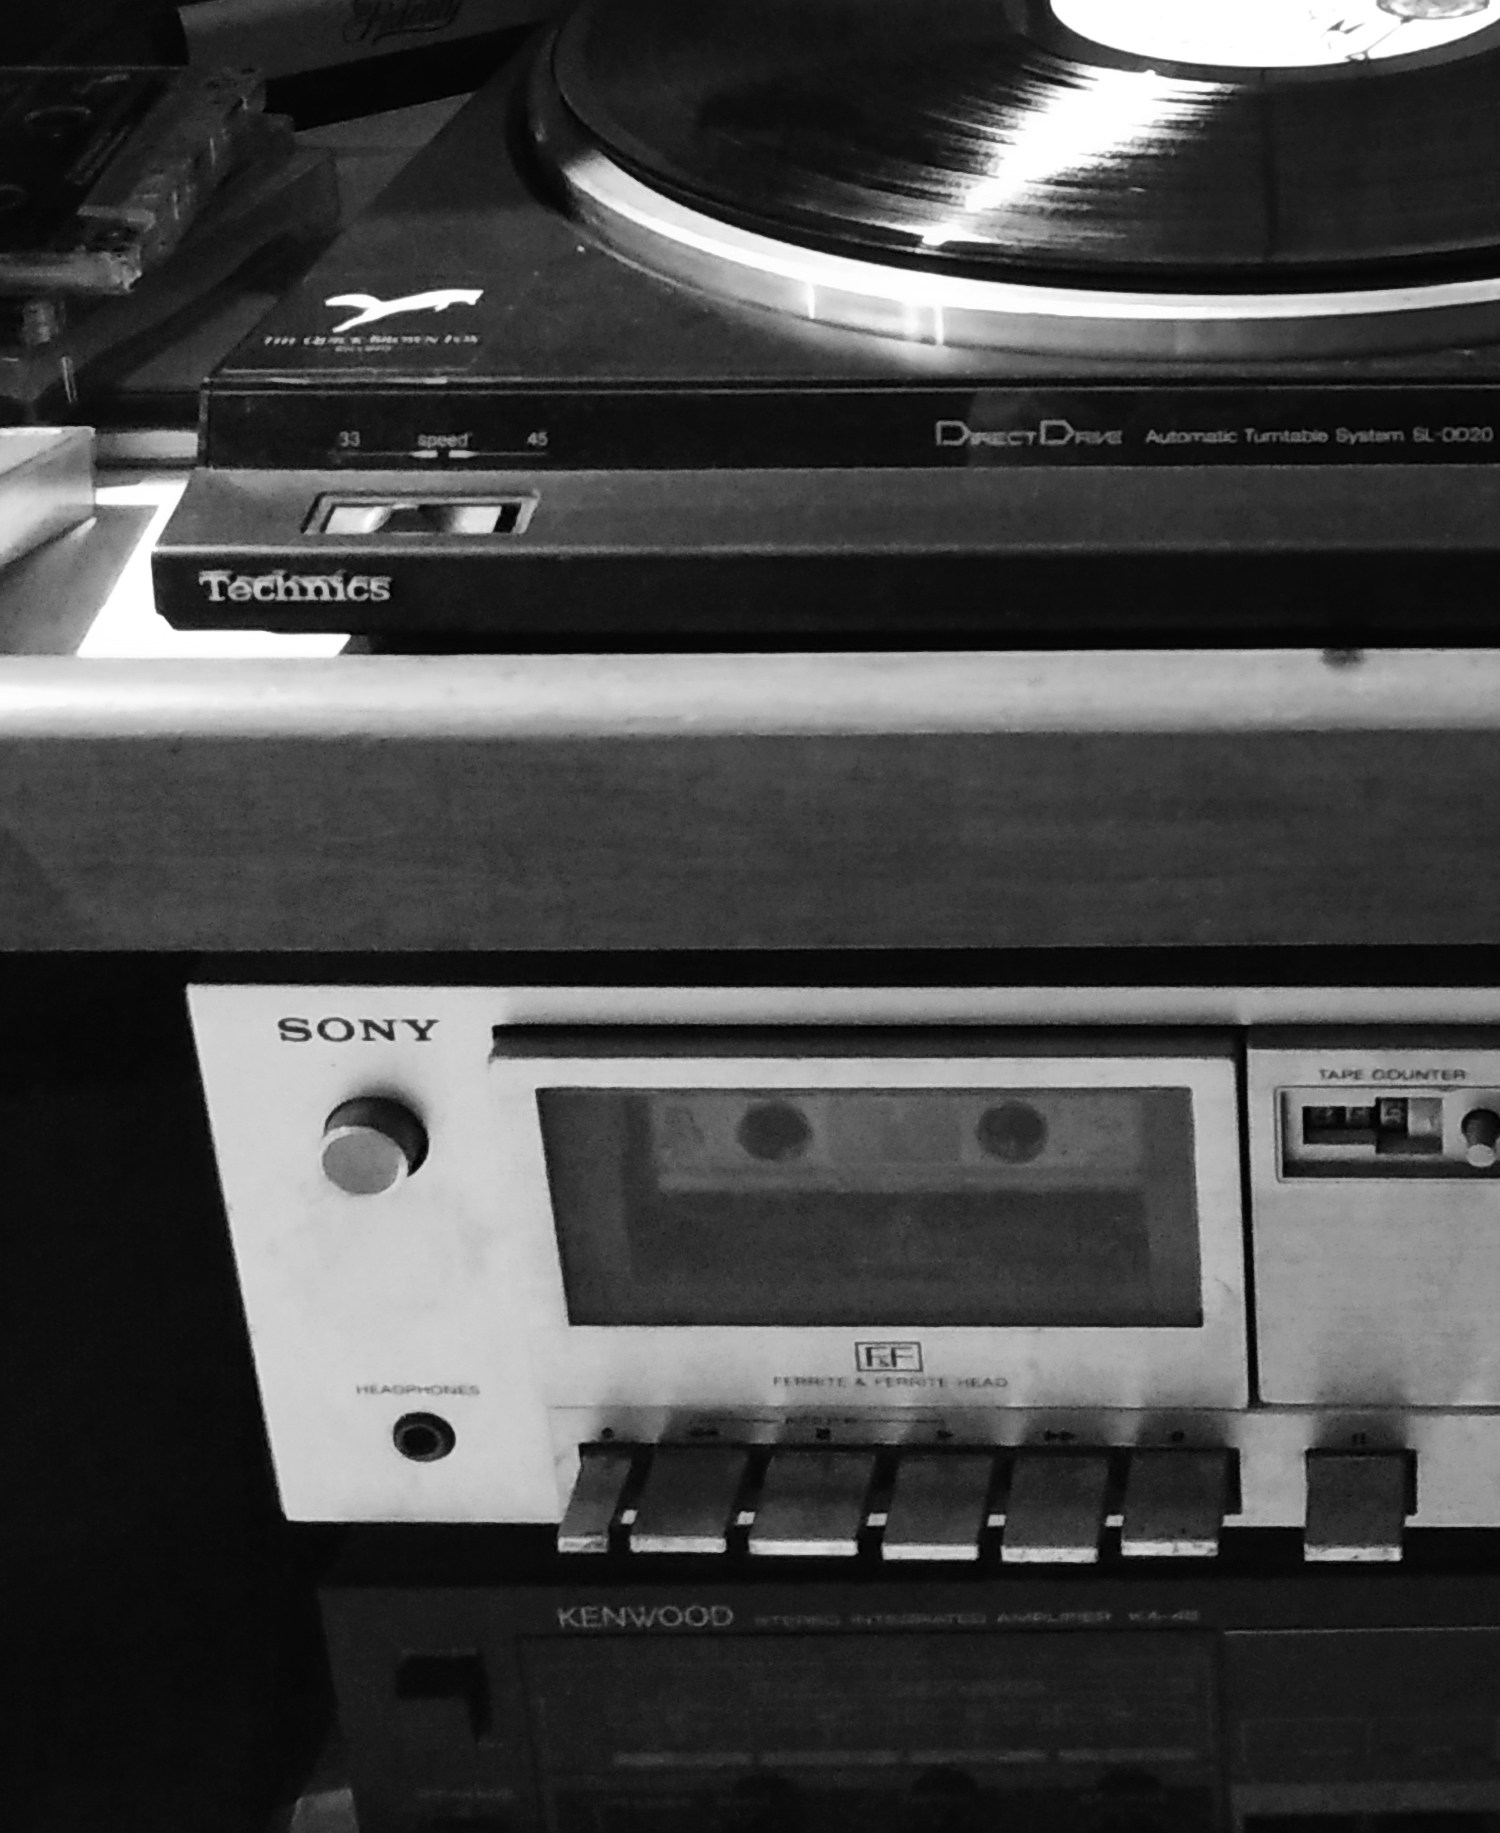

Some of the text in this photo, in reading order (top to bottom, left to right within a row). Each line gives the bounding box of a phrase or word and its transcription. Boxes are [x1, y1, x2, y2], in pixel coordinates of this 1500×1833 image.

[338, 431, 549, 449] 33 speed 45
[1145, 427, 1237, 444] Automatic
[1245, 427, 1329, 444] Turntable
[1336, 427, 1404, 445] System
[200, 570, 391, 602] Technics
[277, 1017, 439, 1043] SONY
[1318, 1067, 1468, 1081] TAPE COUNTER
[355, 1383, 480, 1397] HEADPHONES
[958, 1376, 1009, 1389] HEAD
[556, 1605, 735, 1628] KENWOOD
